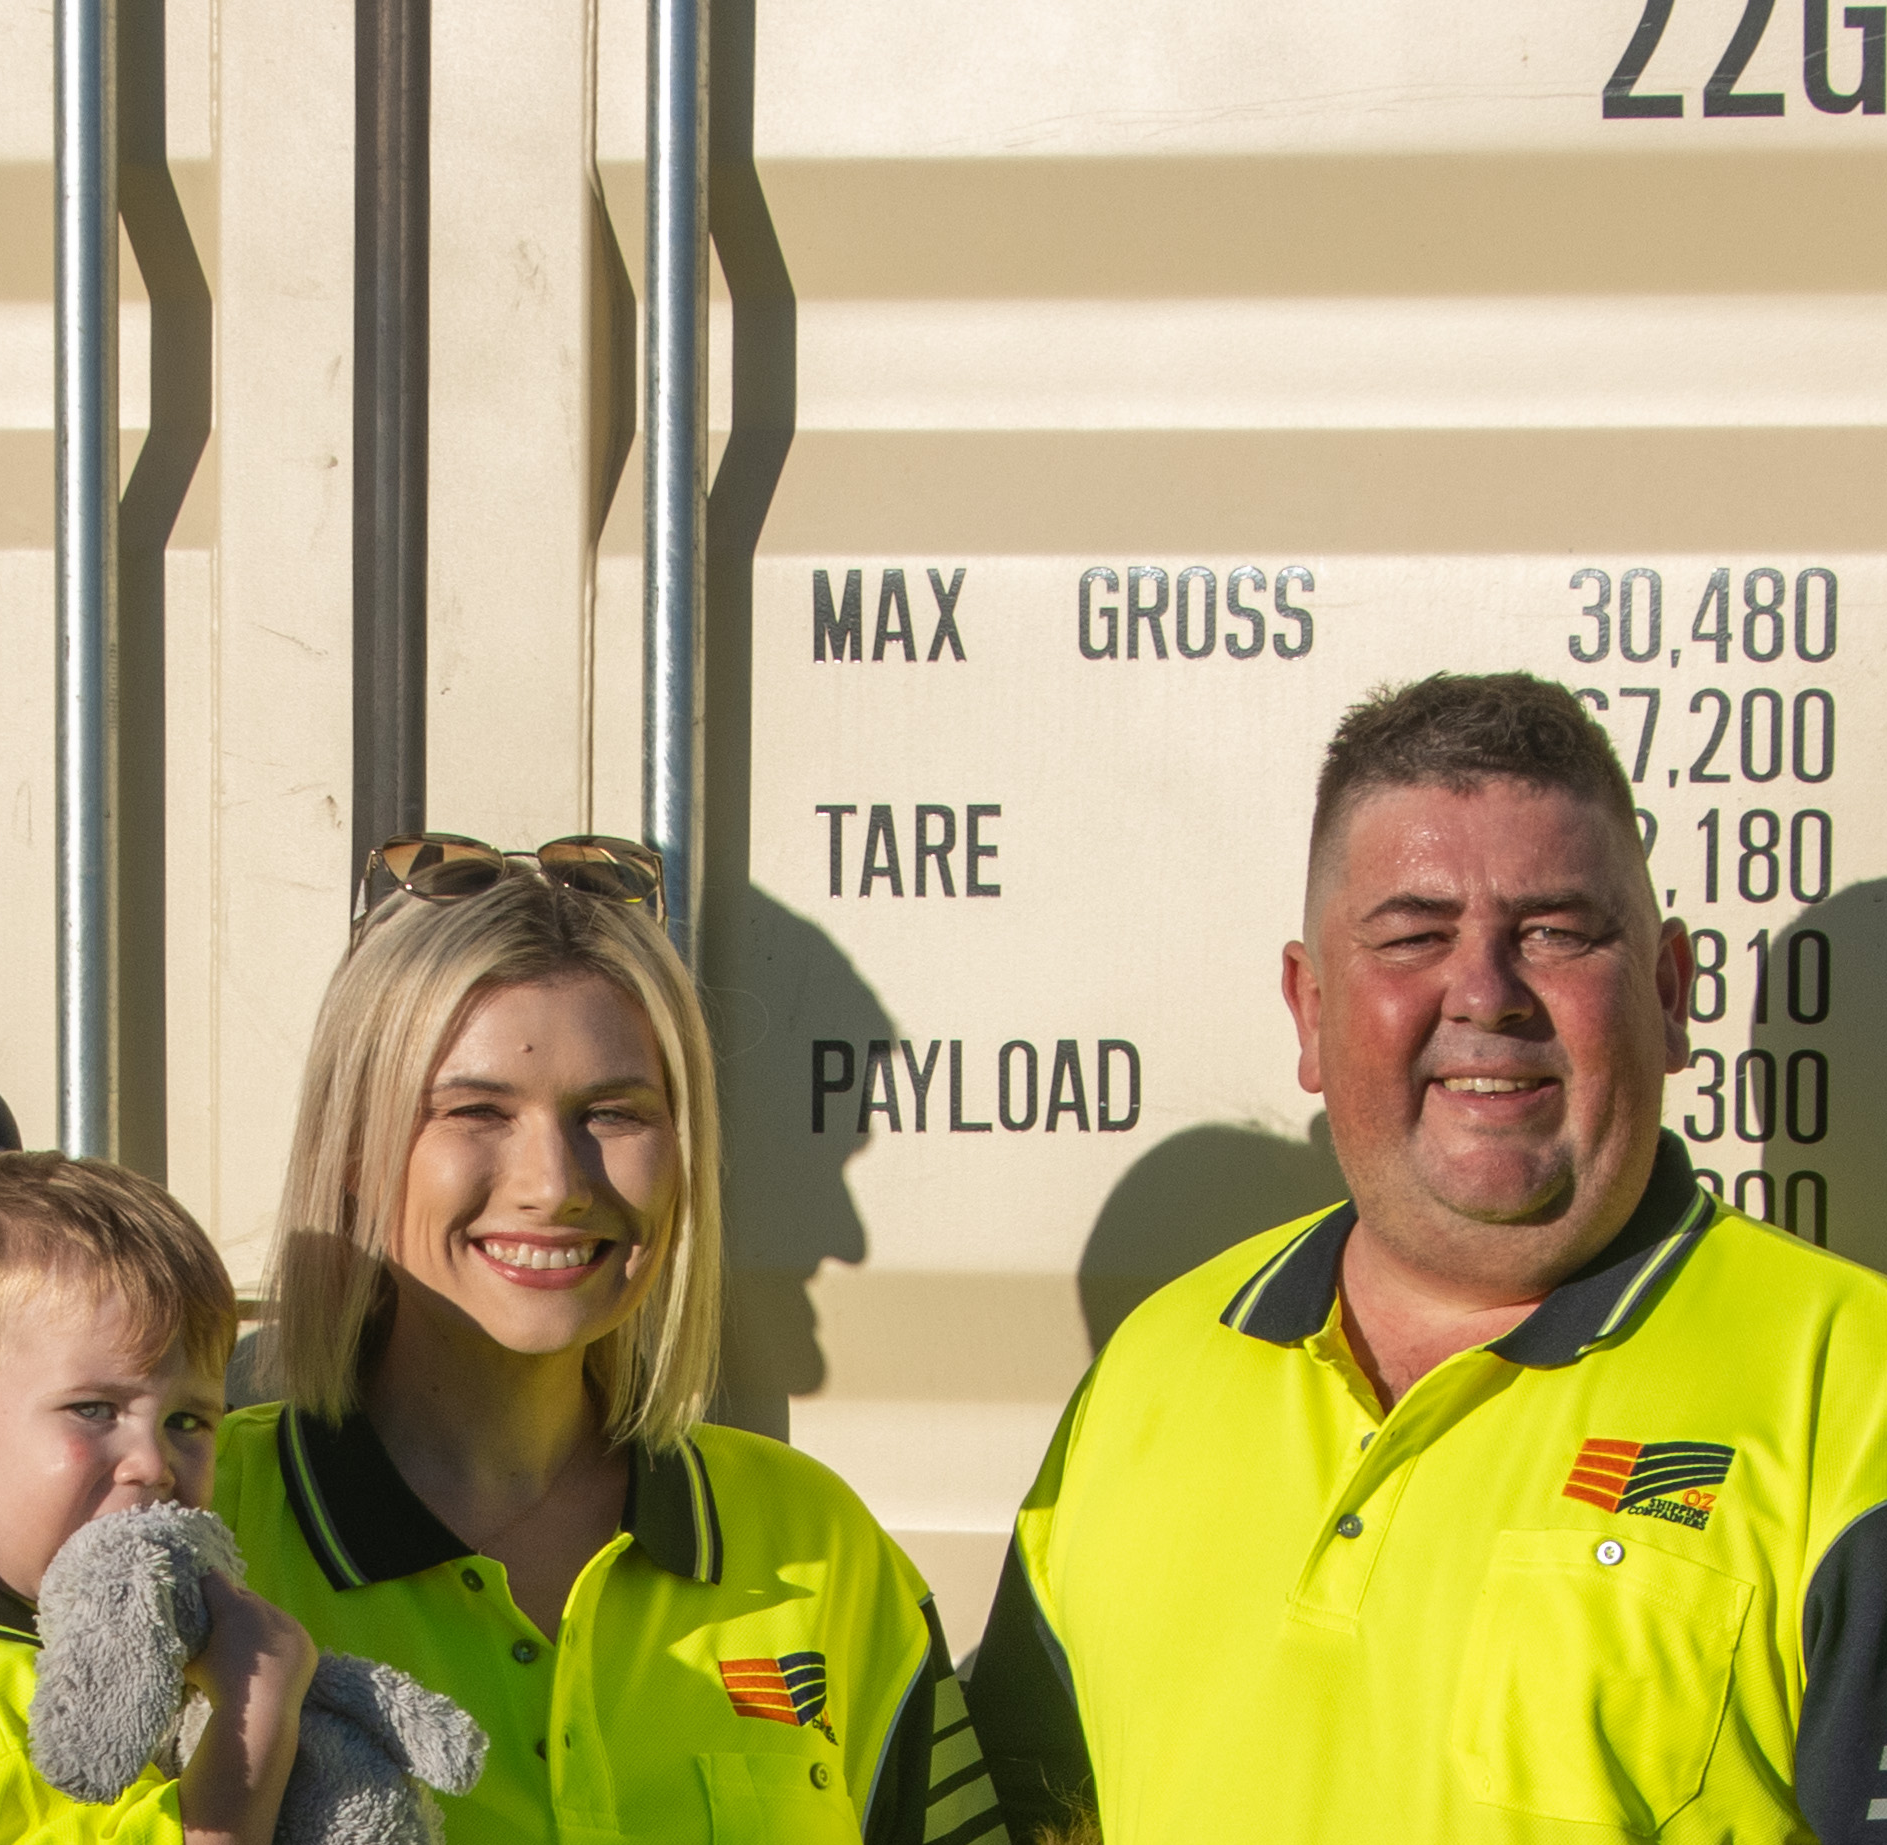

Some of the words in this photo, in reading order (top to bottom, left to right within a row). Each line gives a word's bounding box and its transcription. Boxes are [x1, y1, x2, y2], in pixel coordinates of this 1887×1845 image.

[812, 568, 966, 663] MAX
[1078, 568, 1315, 661] GROSS
[1568, 567, 1838, 668] 30,480
[1571, 687, 1836, 788] 7,200
[815, 804, 1002, 898] TARE
[810, 1038, 1142, 1135] PAYLOAD
[1683, 1489, 1716, 1511] OZ
